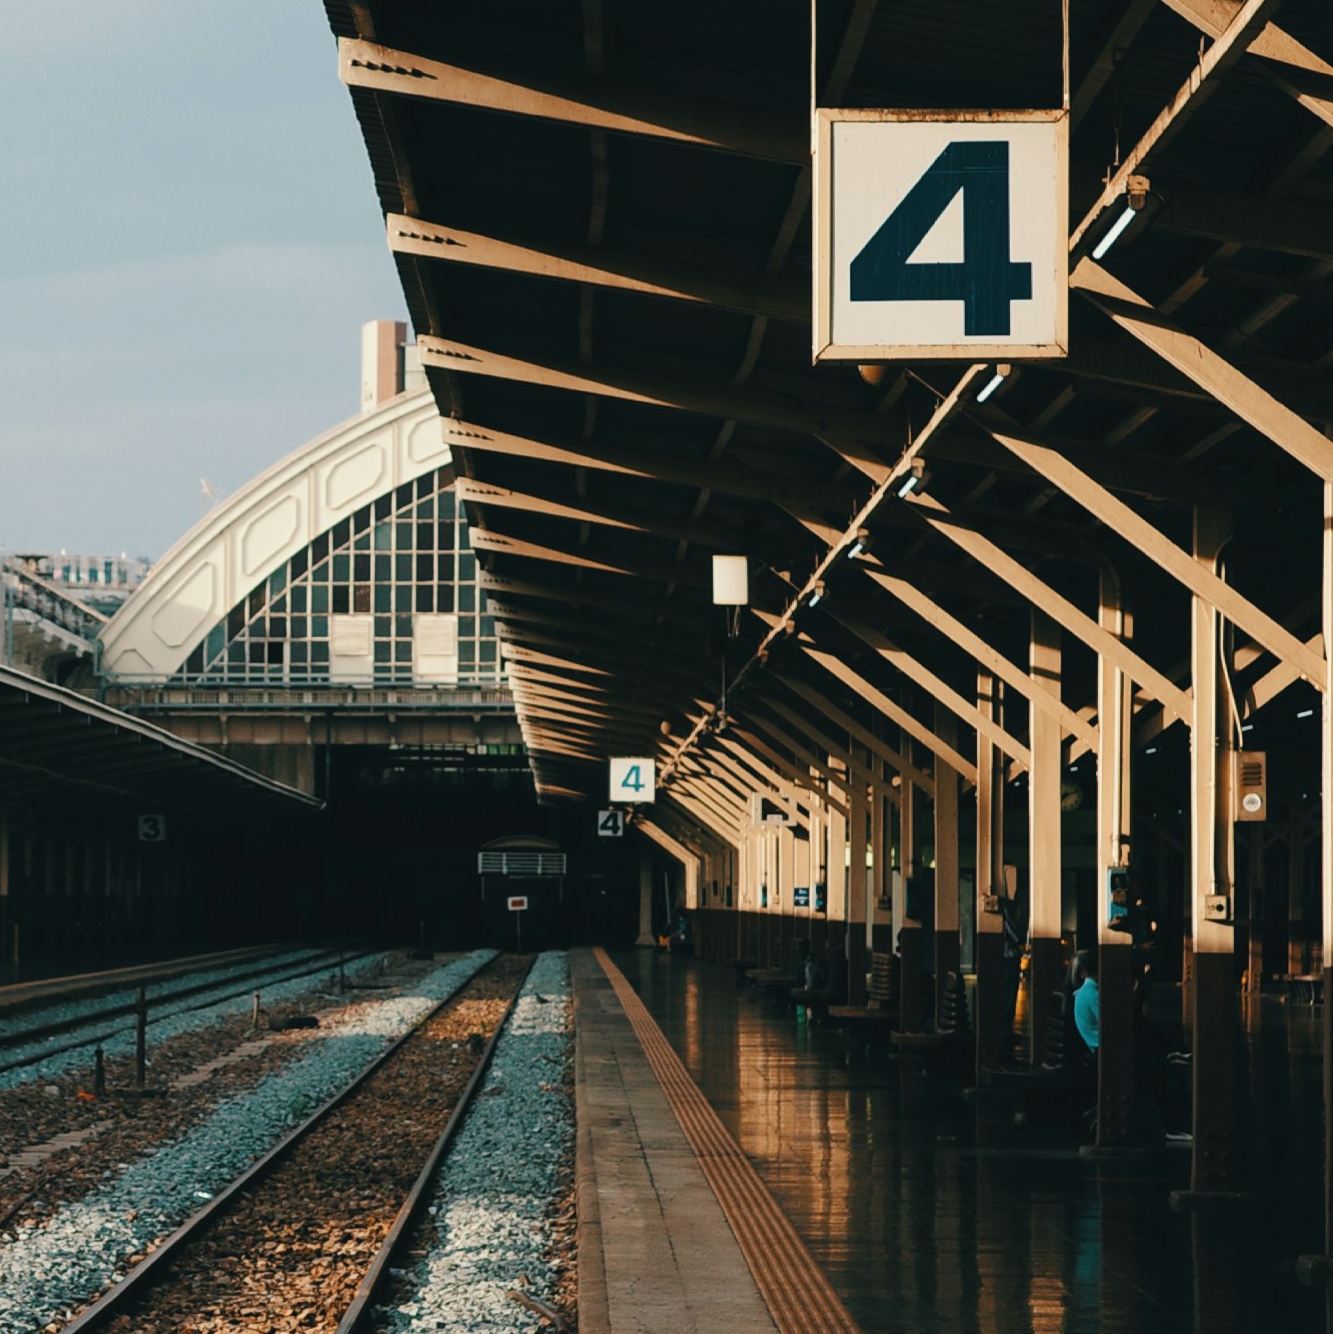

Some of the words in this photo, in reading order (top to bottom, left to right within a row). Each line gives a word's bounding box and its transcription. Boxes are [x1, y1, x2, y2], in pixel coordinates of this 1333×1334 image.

[850, 141, 1032, 336] 4
[621, 765, 645, 792] 4
[142, 817, 160, 839] 3
[600, 812, 620, 834] 4
